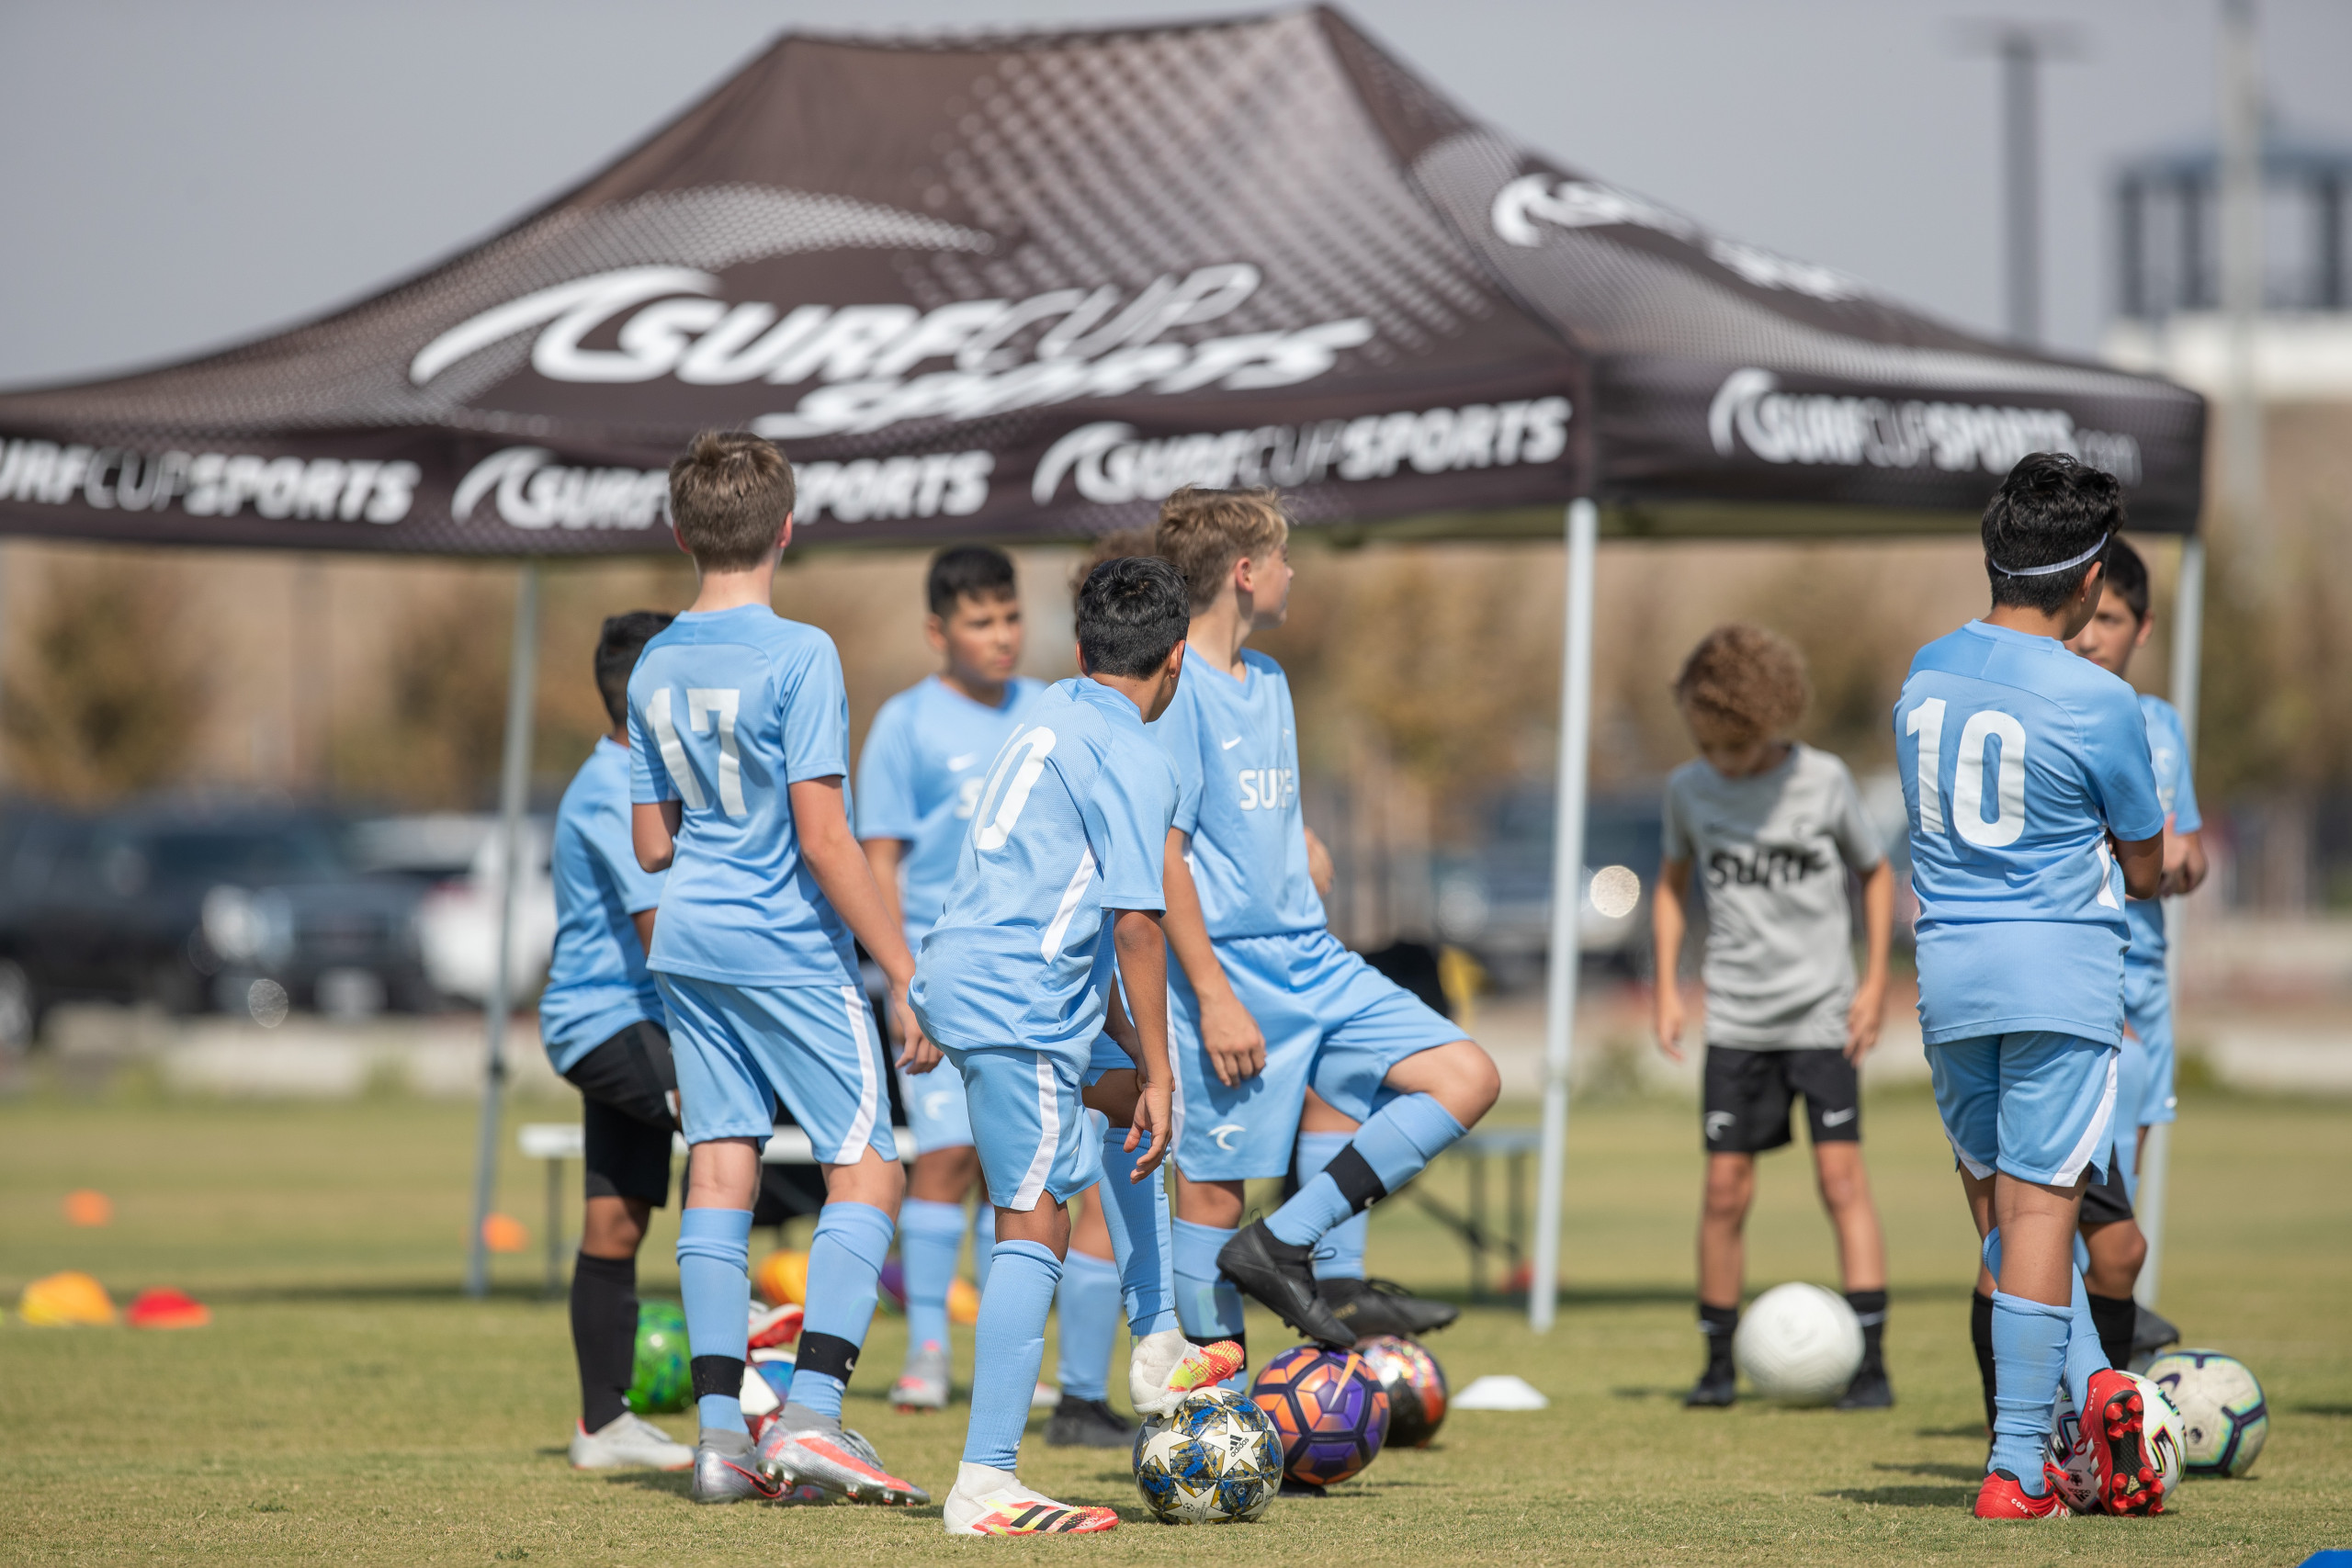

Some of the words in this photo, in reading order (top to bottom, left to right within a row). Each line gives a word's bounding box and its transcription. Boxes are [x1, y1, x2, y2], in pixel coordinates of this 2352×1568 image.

[645, 687, 748, 816] 17
[1906, 696, 2027, 848] 10
[1230, 1437, 1250, 1458] adidas
[2010, 1497, 2030, 1514] COPA
